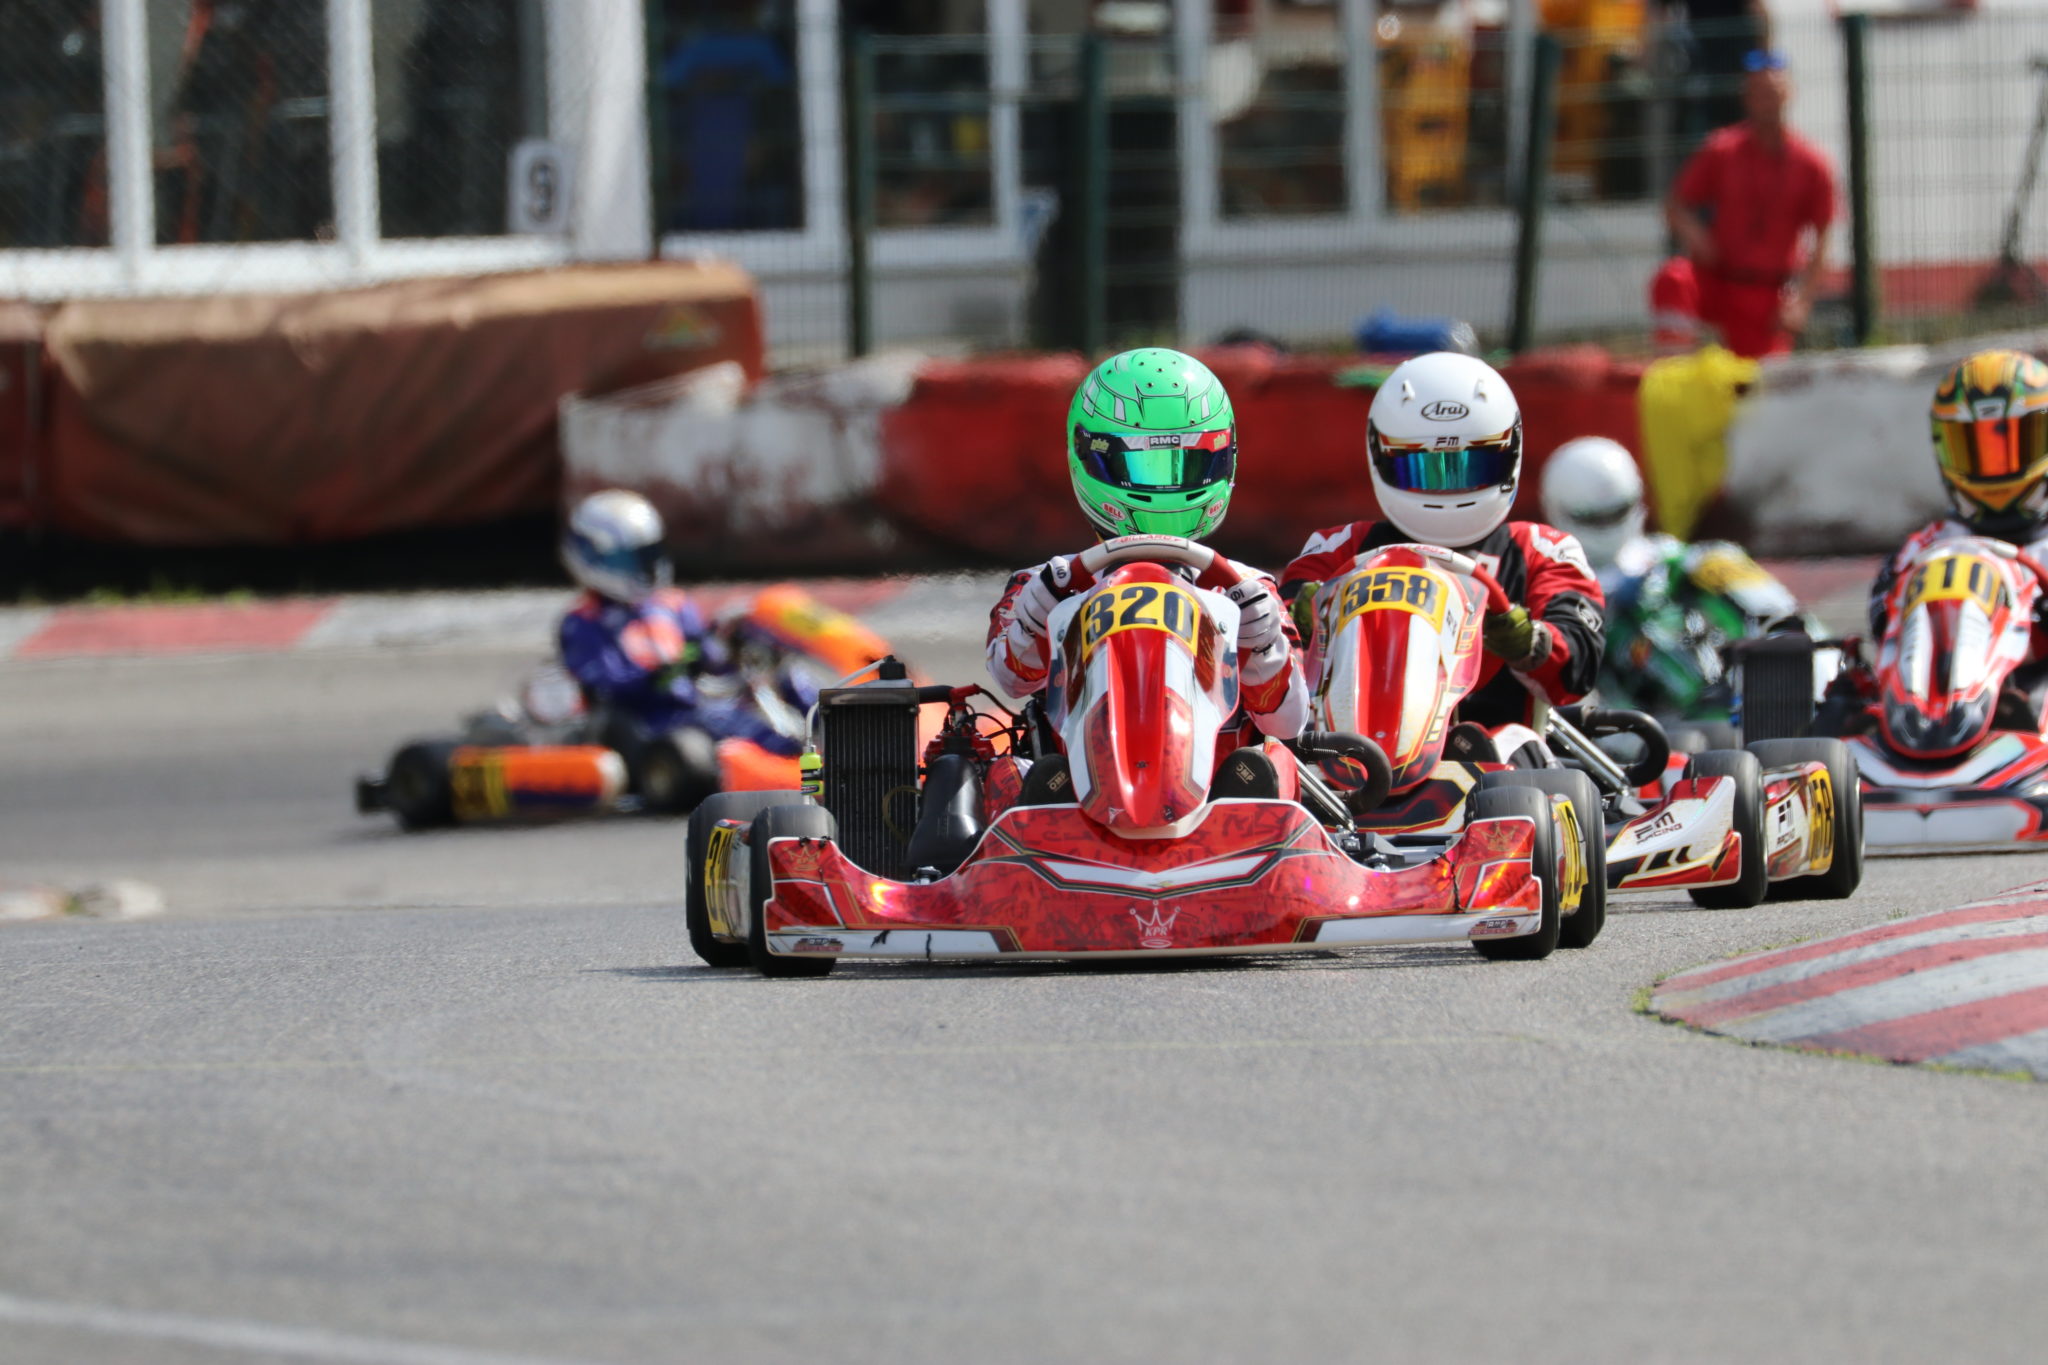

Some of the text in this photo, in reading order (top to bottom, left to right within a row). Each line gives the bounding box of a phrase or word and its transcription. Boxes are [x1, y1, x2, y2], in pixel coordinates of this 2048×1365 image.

[1150, 436, 1180, 445] RMC
[1103, 503, 1123, 519] BELL
[1343, 572, 1437, 616] 358
[1084, 586, 1195, 645] 320
[1236, 762, 1254, 781] OMP
[1049, 772, 1067, 790] OMP
[1145, 927, 1167, 936] KPR
